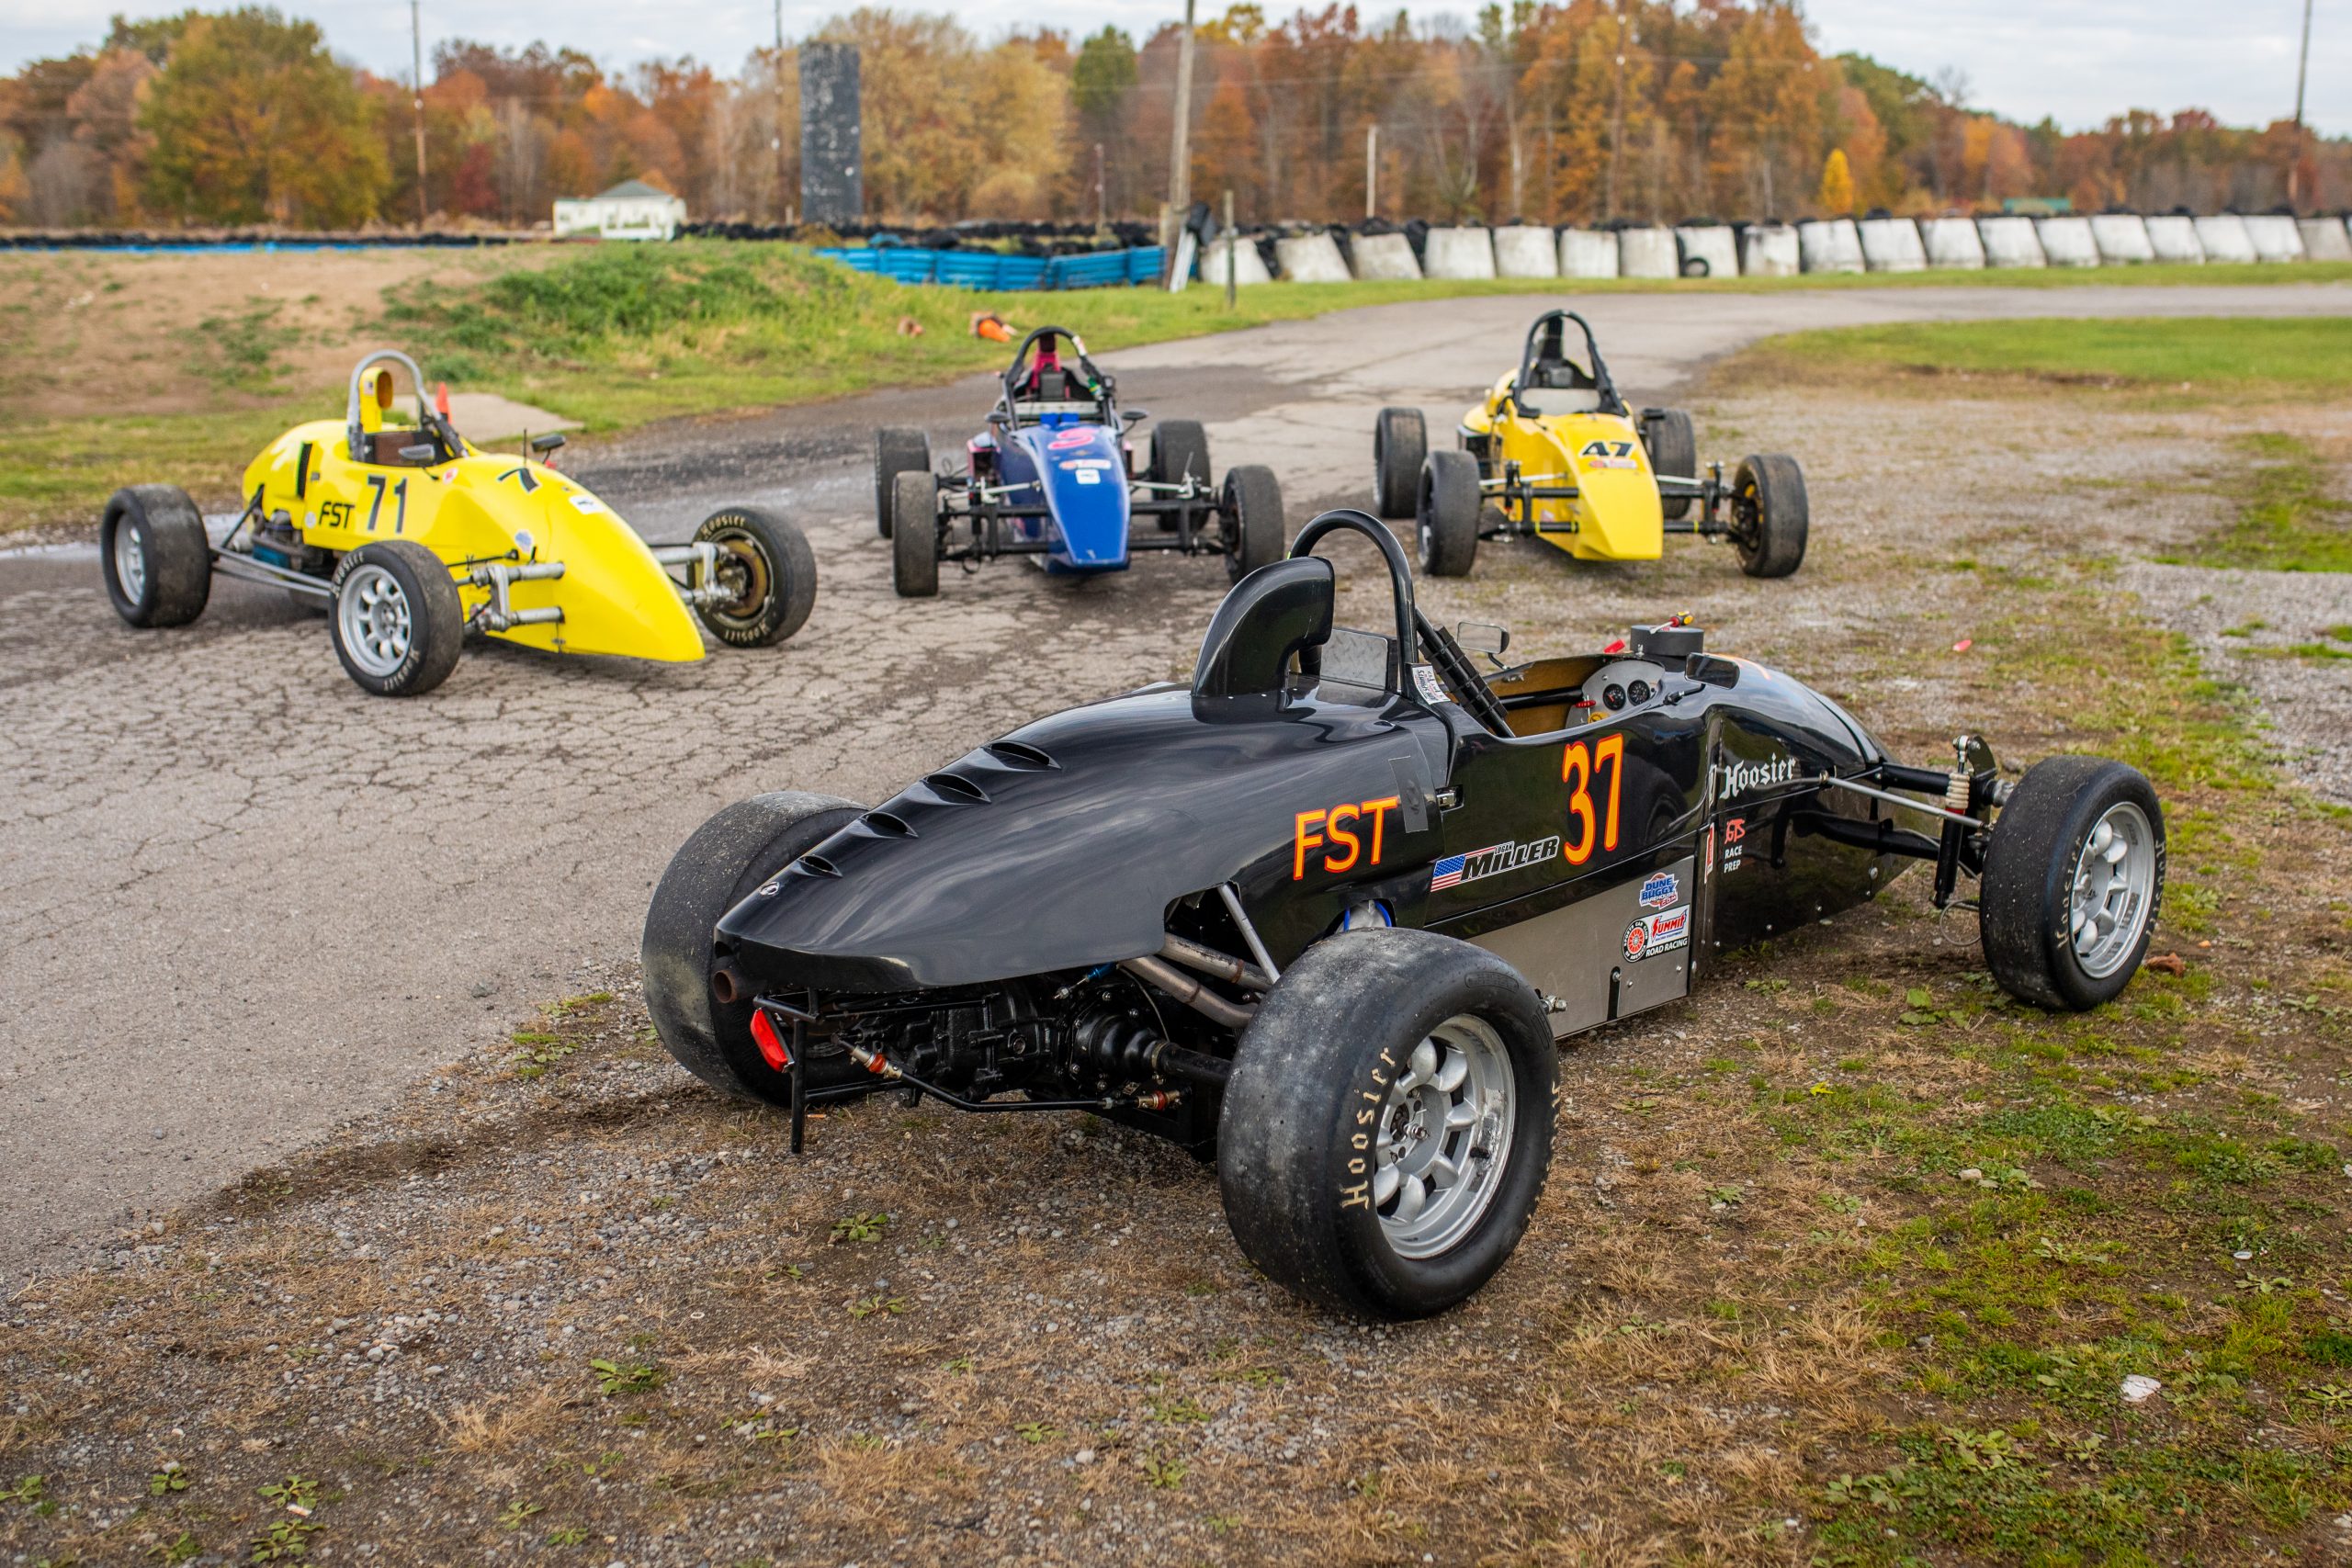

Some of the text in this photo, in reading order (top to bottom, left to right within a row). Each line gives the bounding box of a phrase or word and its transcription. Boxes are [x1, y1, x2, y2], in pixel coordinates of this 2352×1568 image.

[319, 501, 356, 529] FST
[368, 474, 407, 534] 71
[1719, 752, 1796, 799] Hoosier
[1562, 733, 1623, 864] 37
[1294, 796, 1398, 880] FST
[1495, 842, 1514, 854] LOGAN
[1724, 845, 1742, 859] RACE
[1460, 836, 1559, 882] MILLER
[1724, 860, 1741, 874] PREP
[1642, 885, 1675, 900] BUGGY
[1645, 877, 1672, 890] DUNE
[1651, 912, 1687, 940] SUMMIT
[1645, 939, 1688, 957] ROAD RACING
[1339, 1045, 1396, 1211] Hoosier
